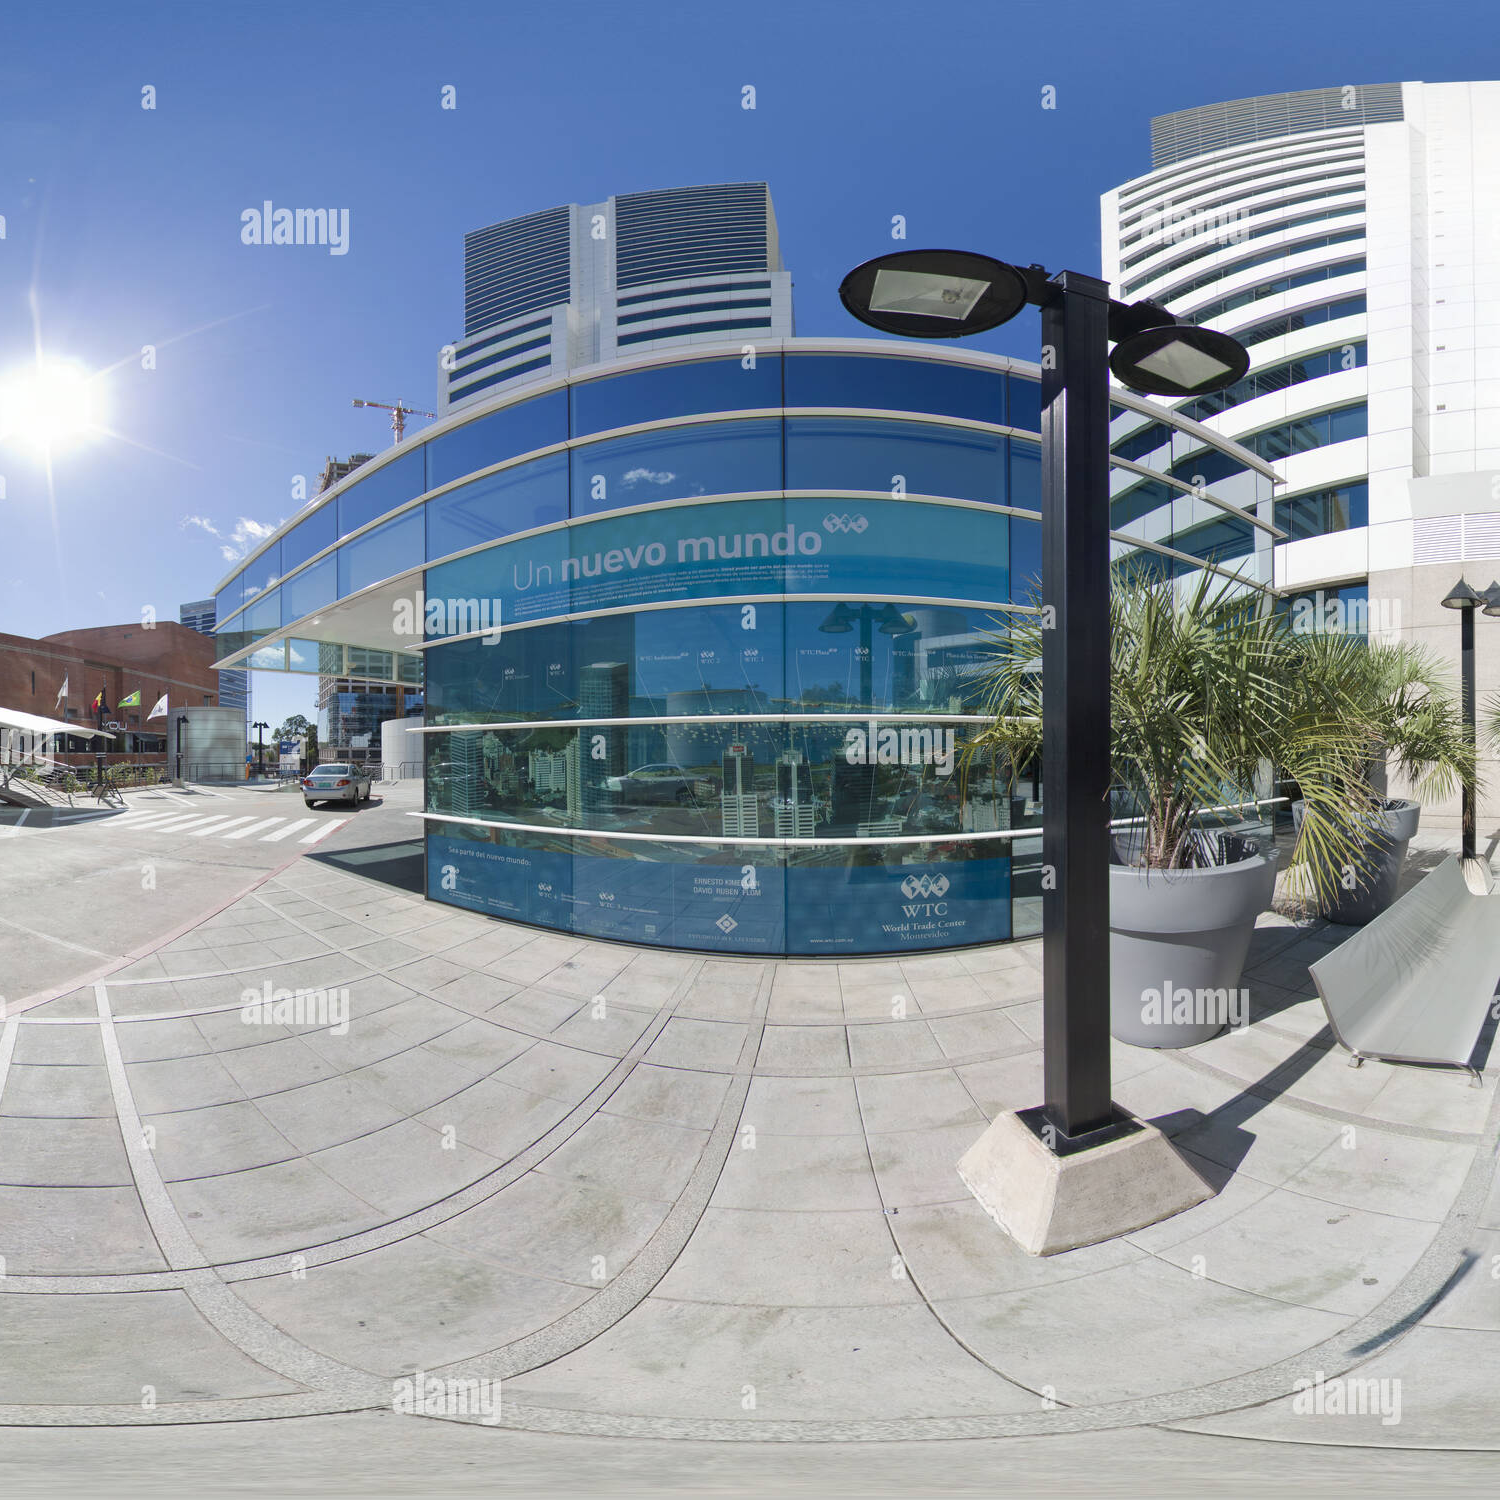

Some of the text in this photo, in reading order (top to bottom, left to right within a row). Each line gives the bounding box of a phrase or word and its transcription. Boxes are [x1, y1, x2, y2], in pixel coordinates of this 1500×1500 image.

[514, 560, 552, 591] Un
[561, 543, 667, 582] nuevo
[678, 524, 822, 563] mundo
[448, 846, 460, 854] Sea
[459, 847, 475, 858] parte
[475, 850, 486, 859] del
[486, 853, 506, 862] nuevo
[694, 878, 724, 886] ERNESTO
[693, 886, 761, 897] DAVID RUBEN FLOM
[902, 902, 948, 918] WTC
[882, 919, 966, 933] World Trade Center
[900, 930, 949, 941] Montevideo
